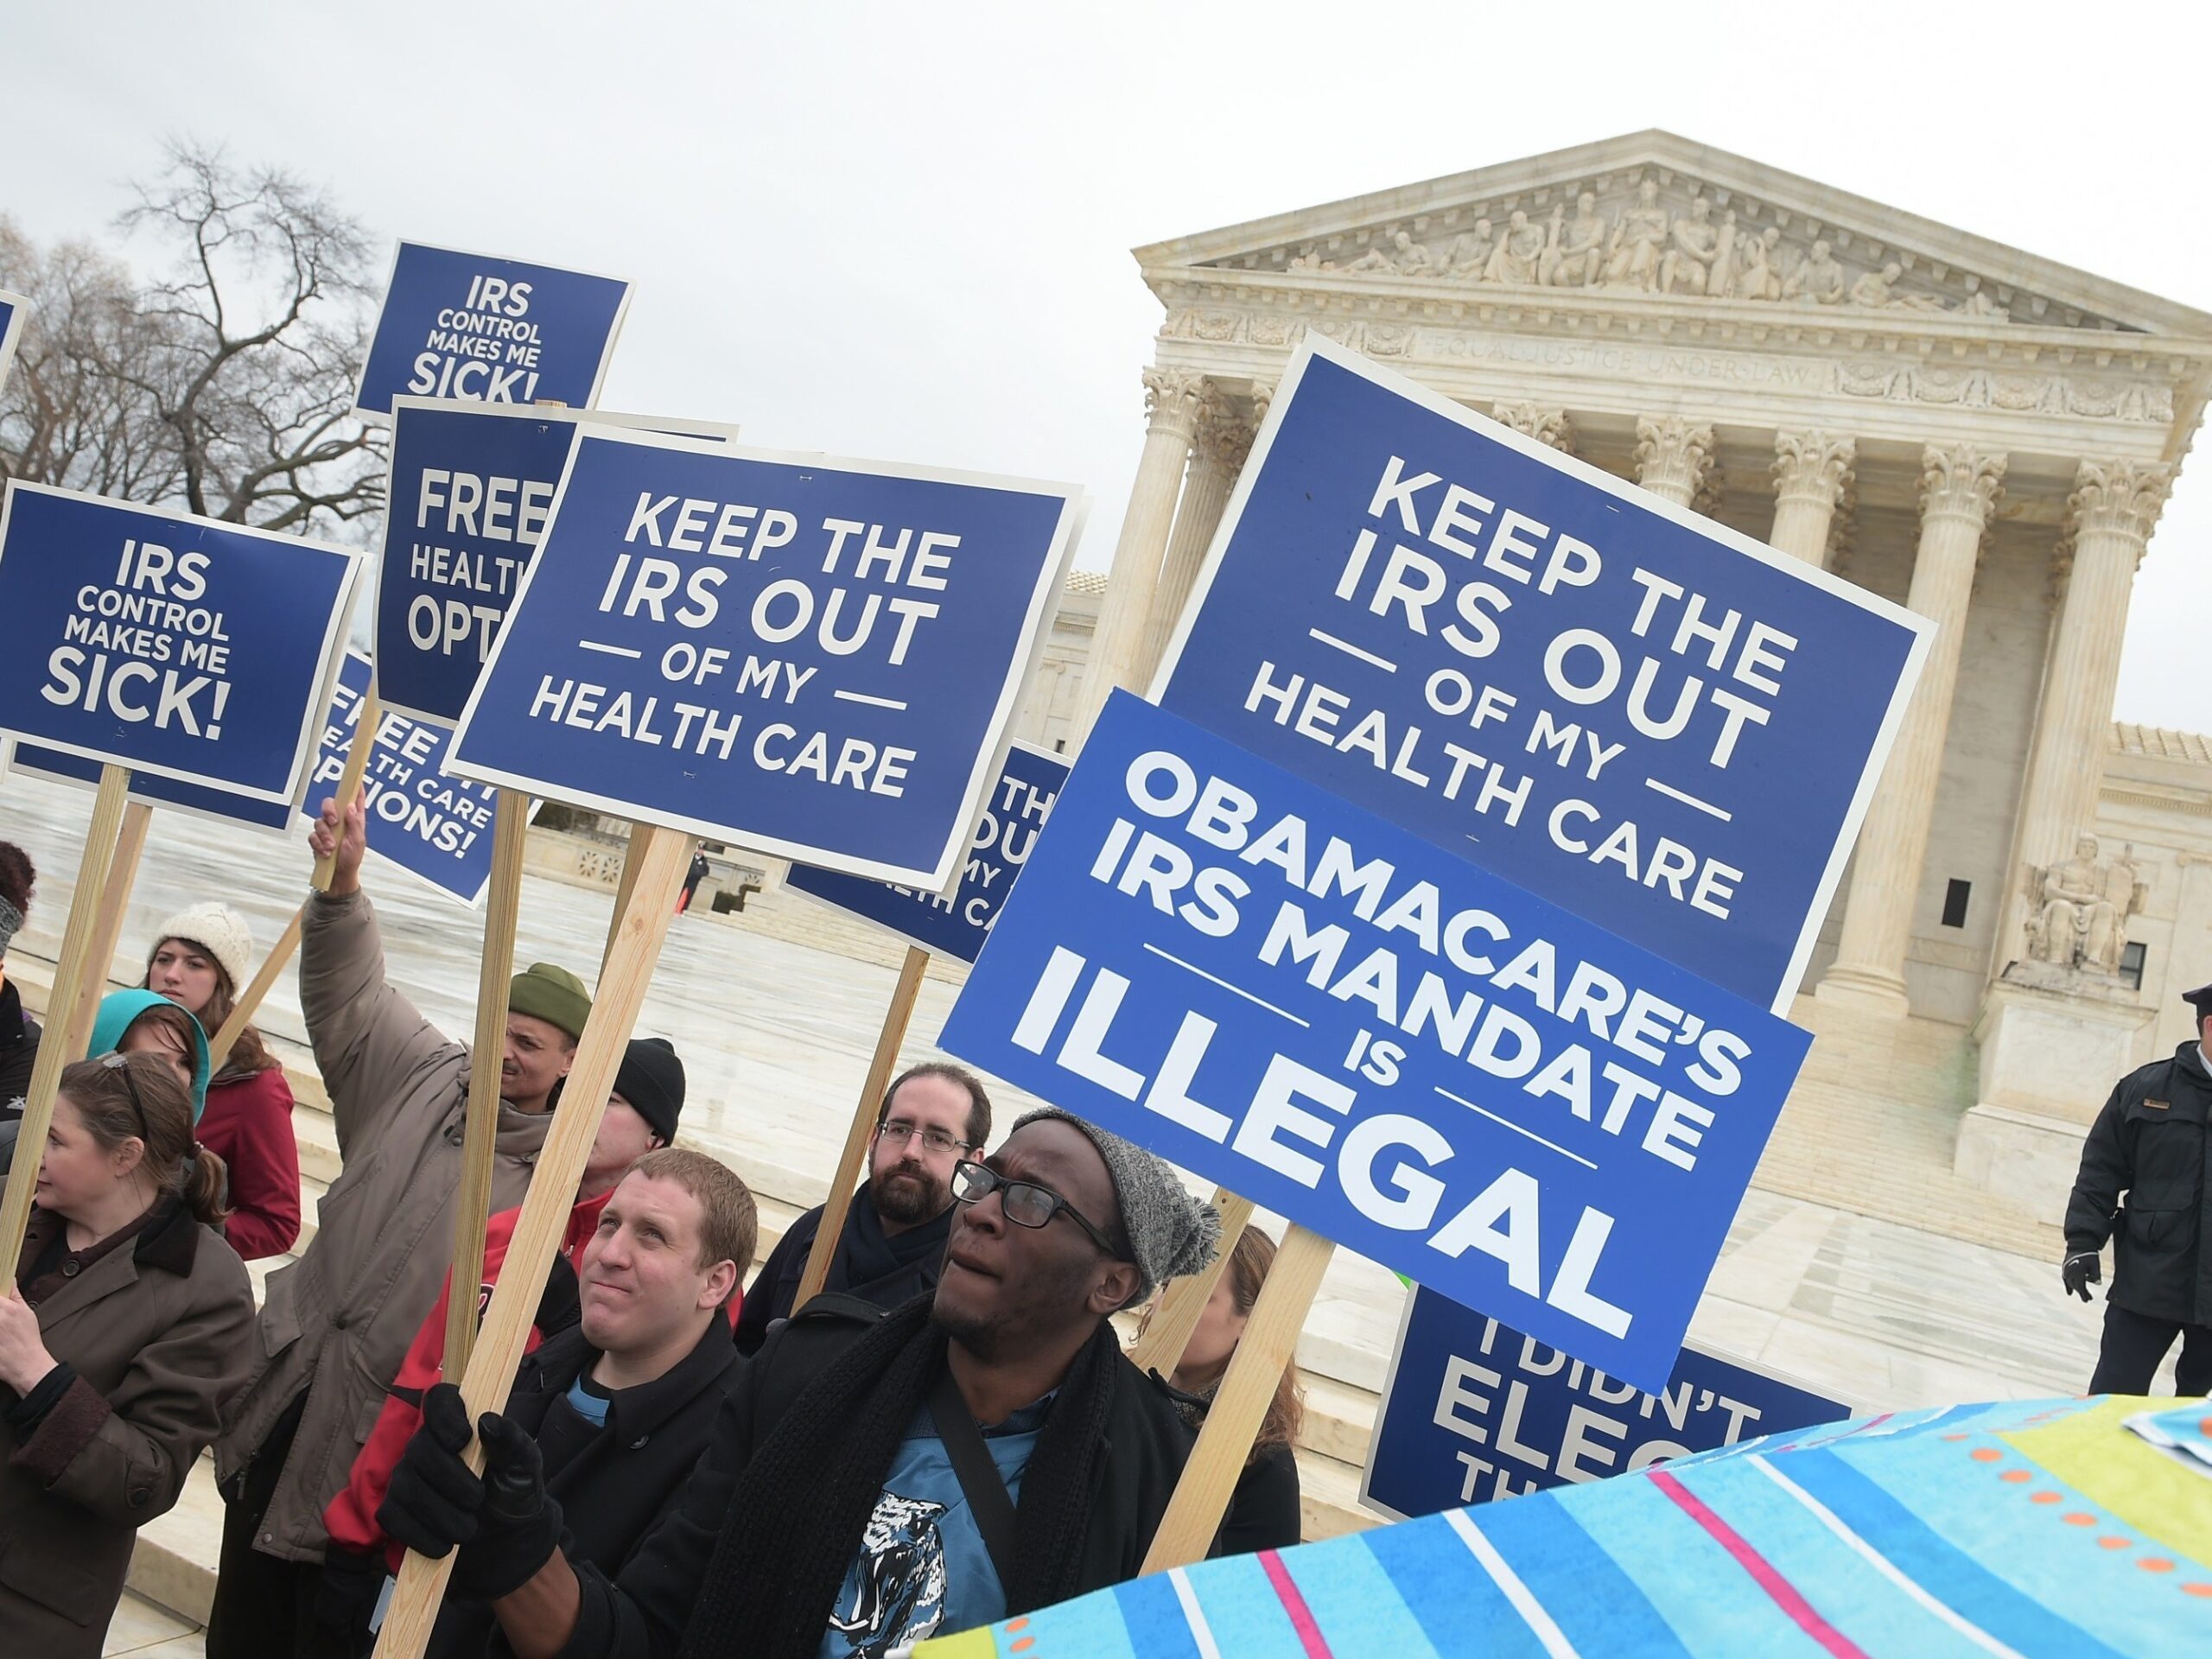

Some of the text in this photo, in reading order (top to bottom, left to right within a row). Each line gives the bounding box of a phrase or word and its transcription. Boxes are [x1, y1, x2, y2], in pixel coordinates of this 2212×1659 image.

[437, 308, 542, 345] CONTROL
[465, 275, 533, 317] IRS
[407, 352, 540, 404] SICK!
[426, 329, 542, 368] MAKES ME
[1645, 351, 1742, 381] UNDER
[417, 467, 554, 545] FREE
[624, 491, 962, 591] KEEP THE
[116, 538, 212, 601] IRS
[1366, 454, 1799, 696] KEEP THE
[64, 613, 231, 675] MAKES ME
[77, 585, 229, 642] CONTROL
[408, 594, 509, 664] OPT
[598, 553, 940, 665] IRS OUT
[661, 642, 819, 705] OF MY
[1334, 527, 1771, 769] IRS OUT
[40, 645, 232, 741] SICK!
[1424, 668, 1627, 782] OF MY
[529, 674, 917, 798] HEALTH CARE
[416, 779, 493, 830] CARE
[1002, 775, 1056, 825] TH
[1243, 660, 1745, 921] HEALTH CARE
[971, 810, 1039, 865] OU
[1125, 750, 1752, 1096] OBAMACARE'S
[1090, 817, 1716, 1173] IRS MANDATE
[1343, 1028, 1400, 1087] IS
[1009, 944, 1634, 1340] ILLEGAL
[1479, 1317, 1762, 1446] I DIDN'T
